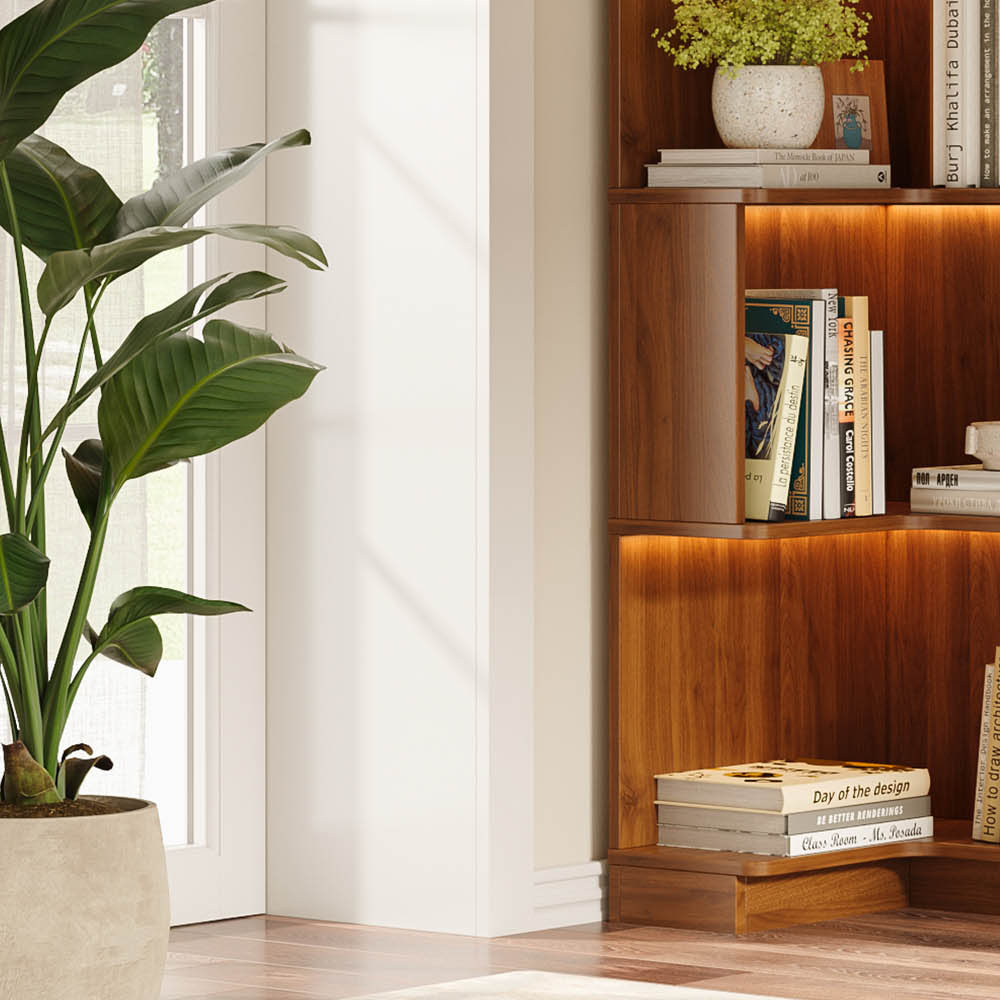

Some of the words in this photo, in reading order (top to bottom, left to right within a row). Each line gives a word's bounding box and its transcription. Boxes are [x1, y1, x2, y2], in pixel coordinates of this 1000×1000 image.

[946, 0, 959, 49] Dubai
[983, 12, 991, 28] the
[983, 32, 991, 43] in
[983, 47, 993, 104] arrangement
[946, 60, 959, 131] Khalifa
[983, 108, 991, 119] an
[983, 123, 991, 144] make
[946, 144, 964, 182] Burj
[983, 149, 991, 159] to
[983, 163, 991, 180] How
[827, 292, 839, 314] New
[843, 321, 854, 375] CHASING
[844, 378, 855, 417] GRACE
[845, 429, 855, 454] Carol
[845, 455, 855, 492] Costello
[936, 472, 959, 488] АРДЕН
[812, 790, 836, 805] Day
[838, 785, 850, 801] of
[852, 784, 871, 800] the
[873, 779, 910, 797] design
[976, 761, 986, 804] Interior
[986, 785, 999, 800] to
[816, 815, 826, 826] BE
[828, 811, 855, 825] BETTER
[857, 804, 904, 821] RENDERINGS
[974, 811, 982, 825] The
[983, 804, 997, 837] How
[801, 836, 828, 852] Class
[829, 832, 857, 849] Room
[888, 822, 923, 842] Posada
